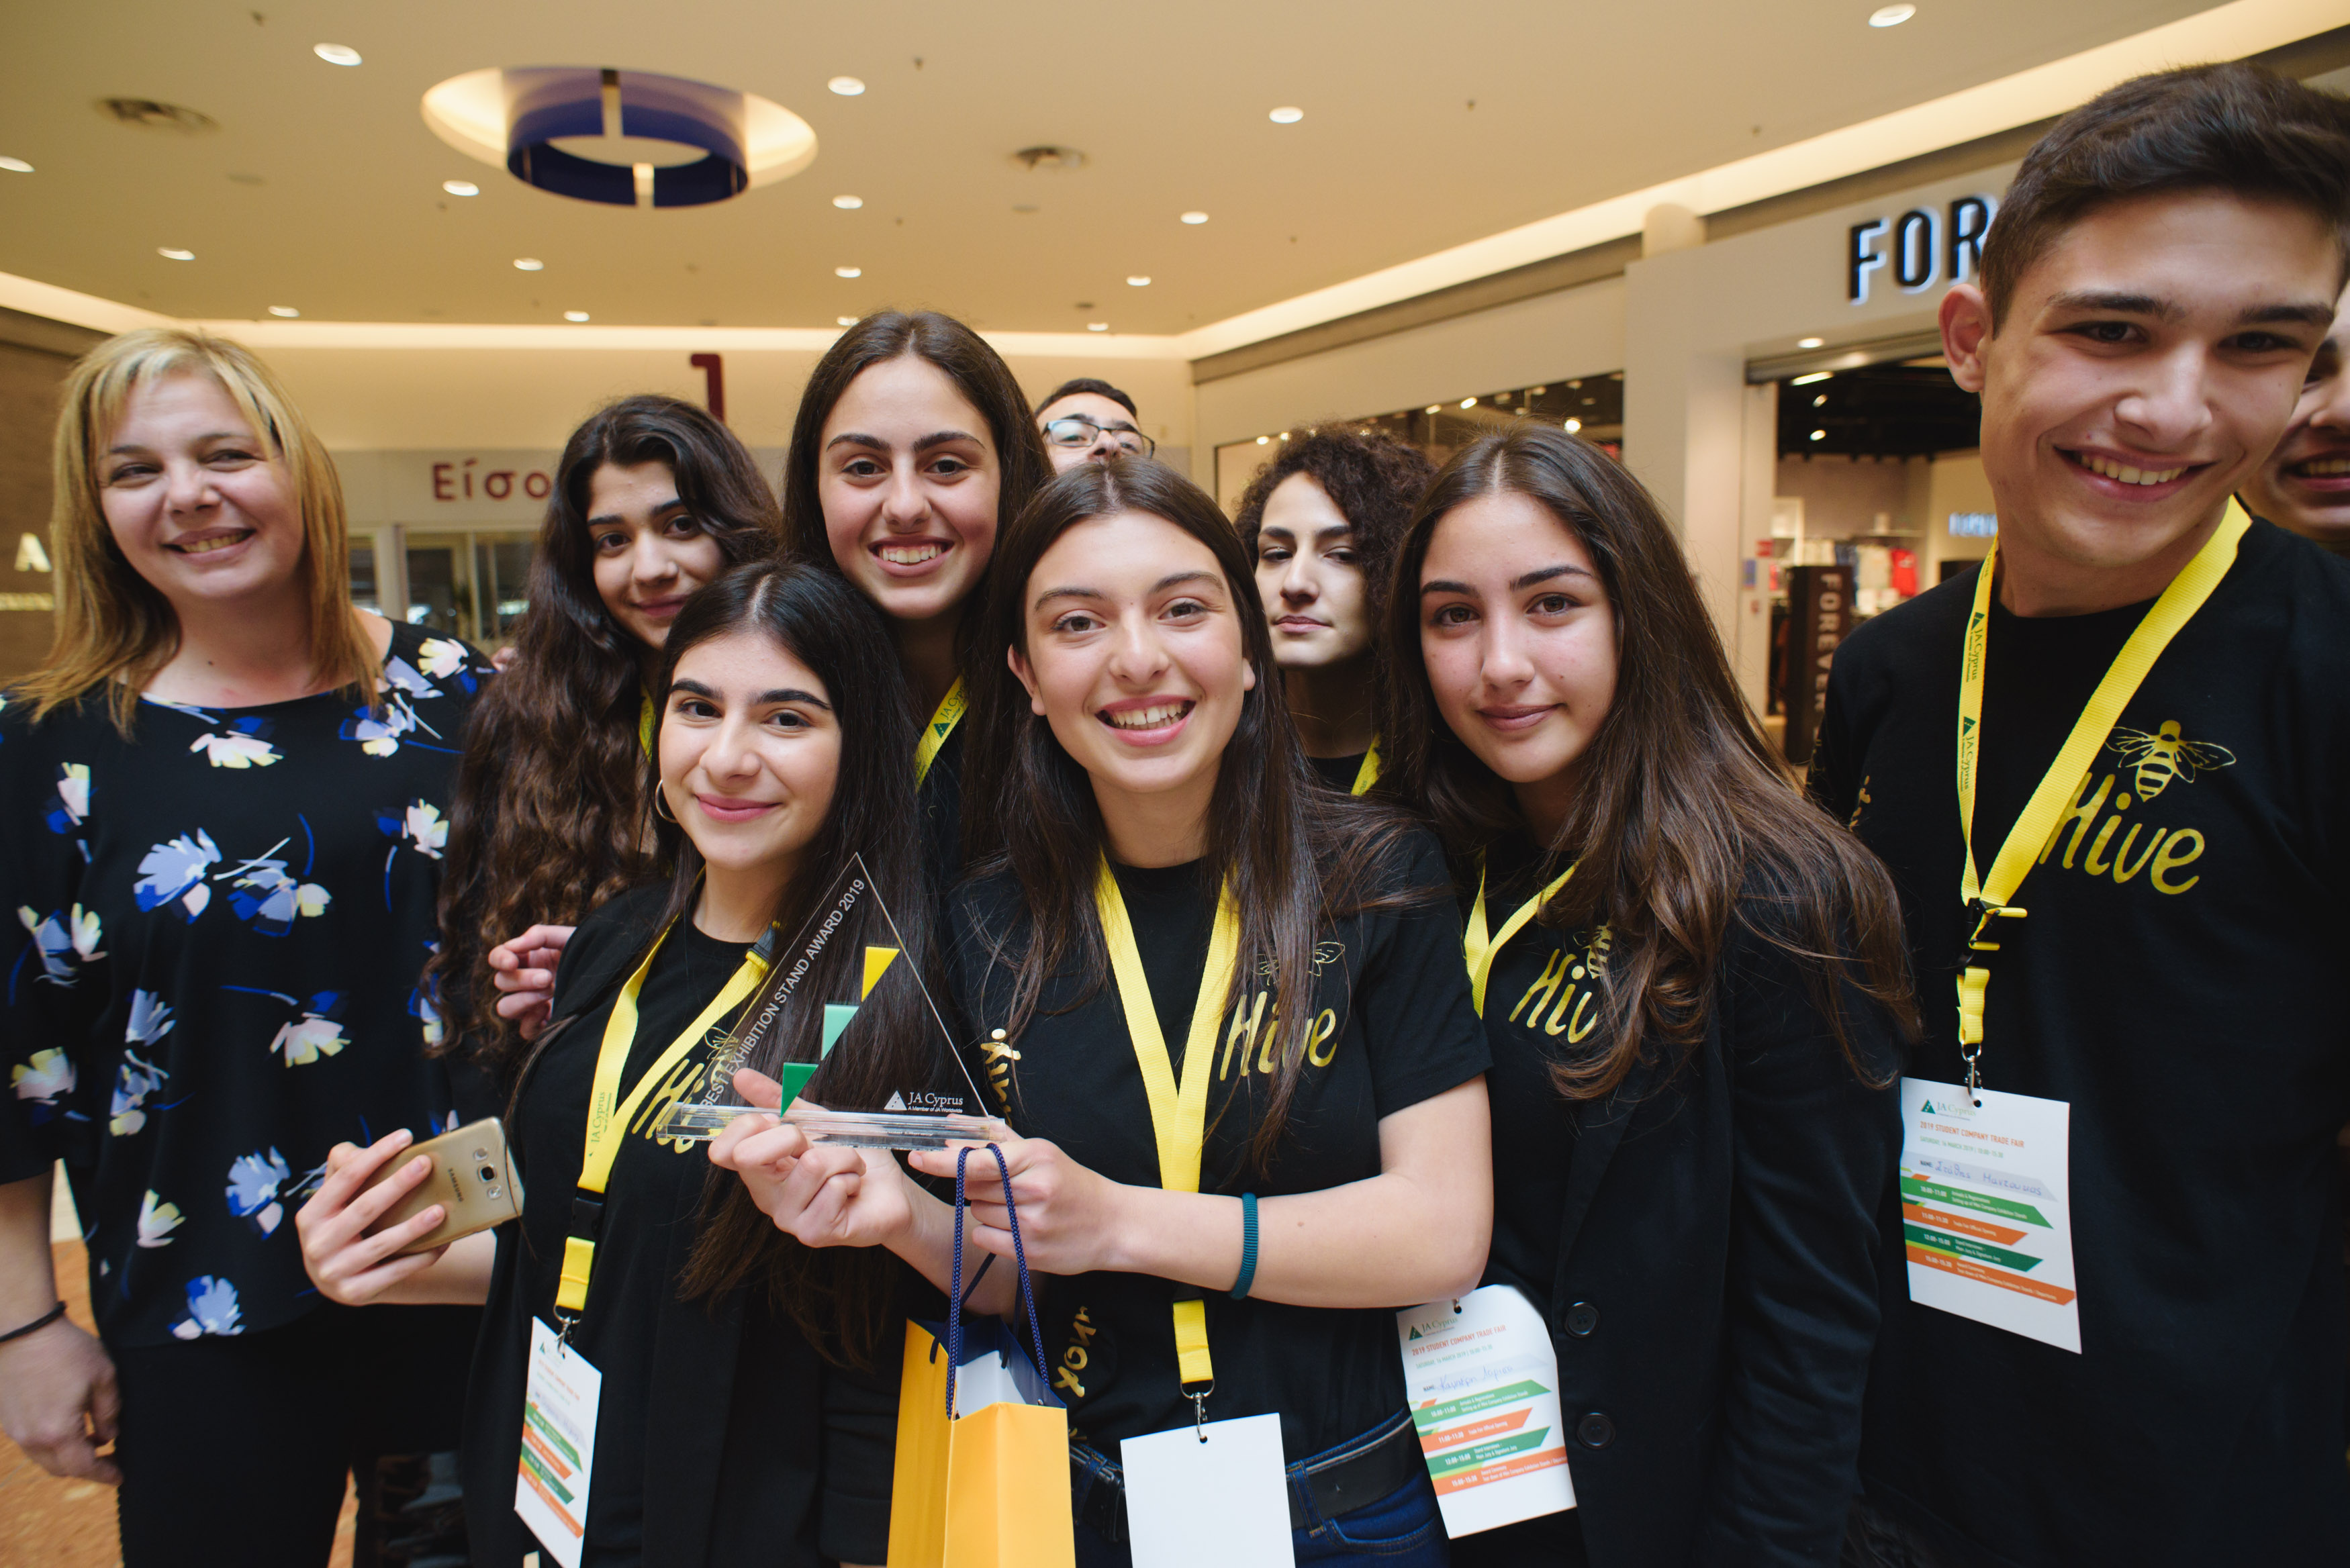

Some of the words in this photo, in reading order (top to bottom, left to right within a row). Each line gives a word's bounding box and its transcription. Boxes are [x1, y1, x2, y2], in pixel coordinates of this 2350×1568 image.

[1849, 195, 1995, 304] FOR
[2038, 772, 2206, 895] Hive
[700, 1073, 729, 1106] BEST
[725, 1002, 780, 1076] EXHIBITION
[774, 959, 810, 1003] STAND
[806, 910, 843, 961] AWARD
[839, 879, 865, 912] 2019
[1509, 948, 1599, 1044] Hiv
[907, 1091, 923, 1106] JA
[925, 1093, 963, 1108] Cyprus
[1935, 1124, 1959, 1134] STUDENT
[1961, 1129, 1988, 1140] COMPANY
[1989, 1134, 2009, 1144] TRADE
[2010, 1139, 2024, 1148] FAIR
[447, 1167, 464, 1203] SAMSUNG
[1412, 1346, 1425, 1355] 2019
[1426, 1339, 1449, 1351] STUDENT
[1450, 1332, 1475, 1344] COMPANY
[1476, 1328, 1493, 1338] TRADE
[1494, 1324, 1506, 1333] FAIR
